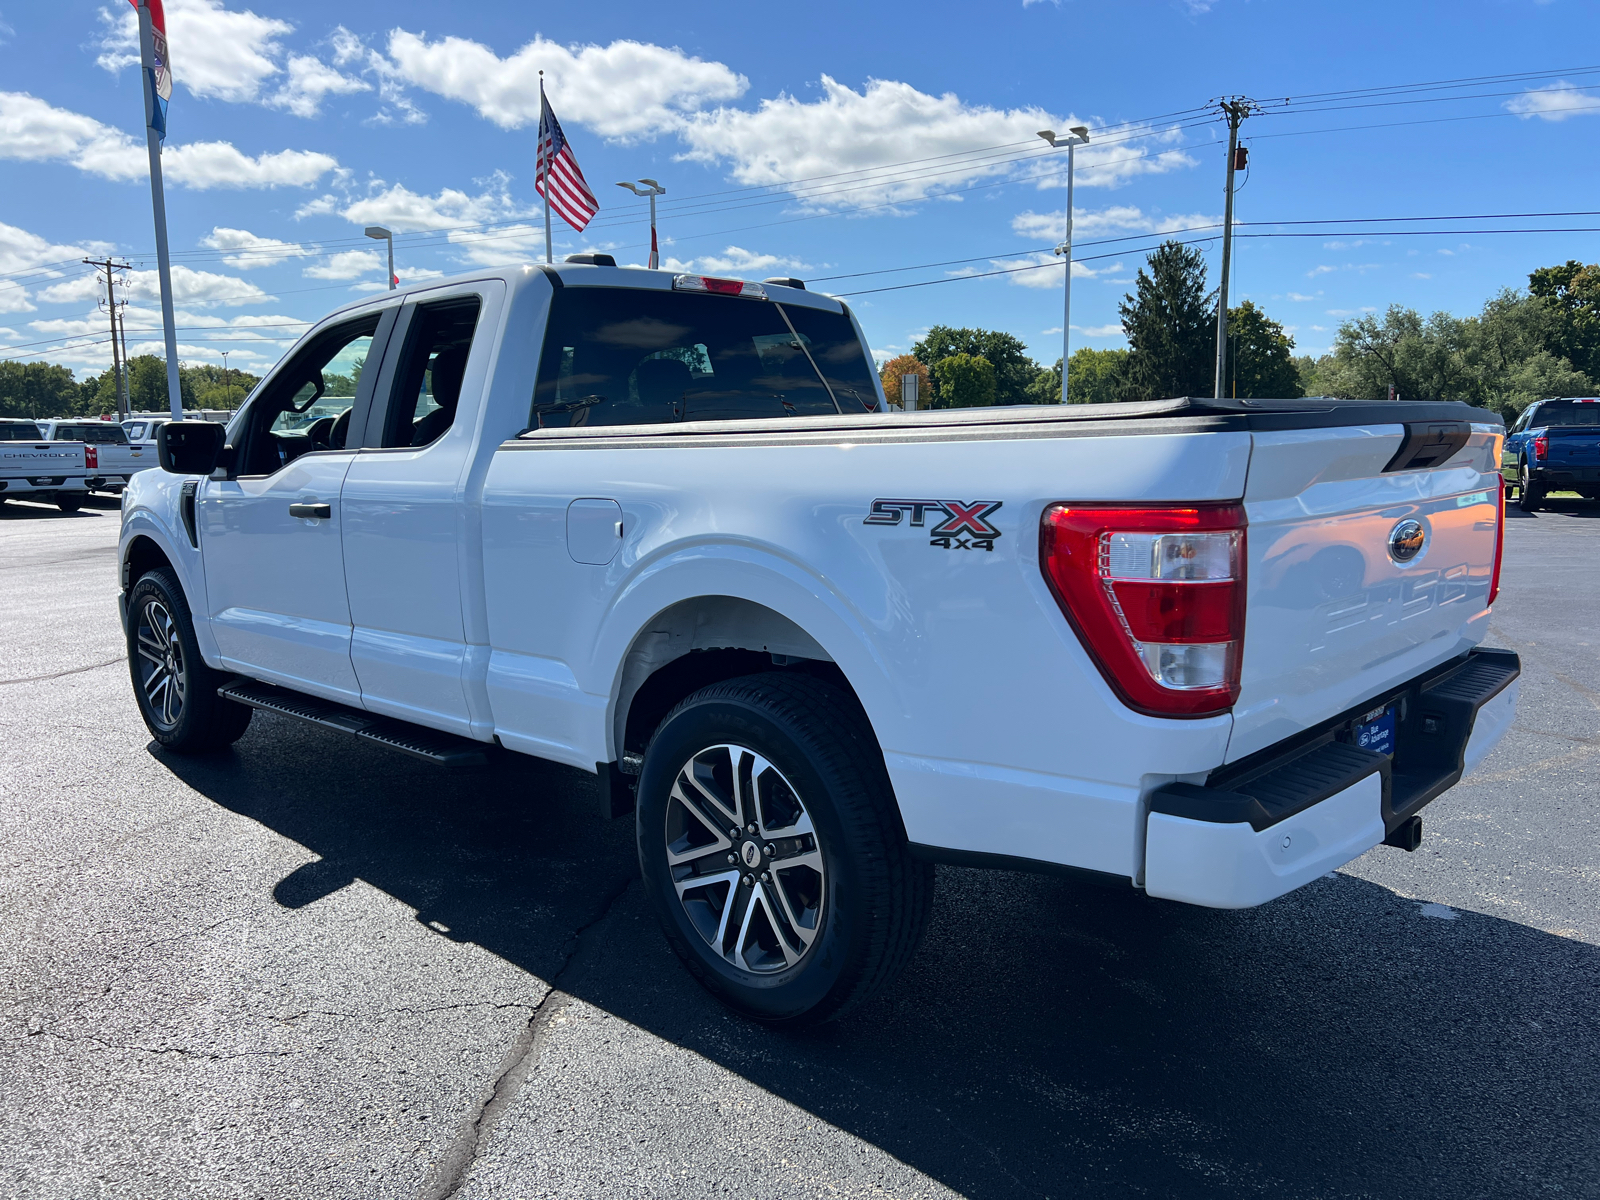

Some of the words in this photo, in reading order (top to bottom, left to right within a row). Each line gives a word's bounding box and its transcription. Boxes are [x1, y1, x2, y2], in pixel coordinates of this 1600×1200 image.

[863, 497, 1003, 539] STX
[1371, 726, 1379, 735] Blue
[1371, 729, 1389, 743] Advantage
